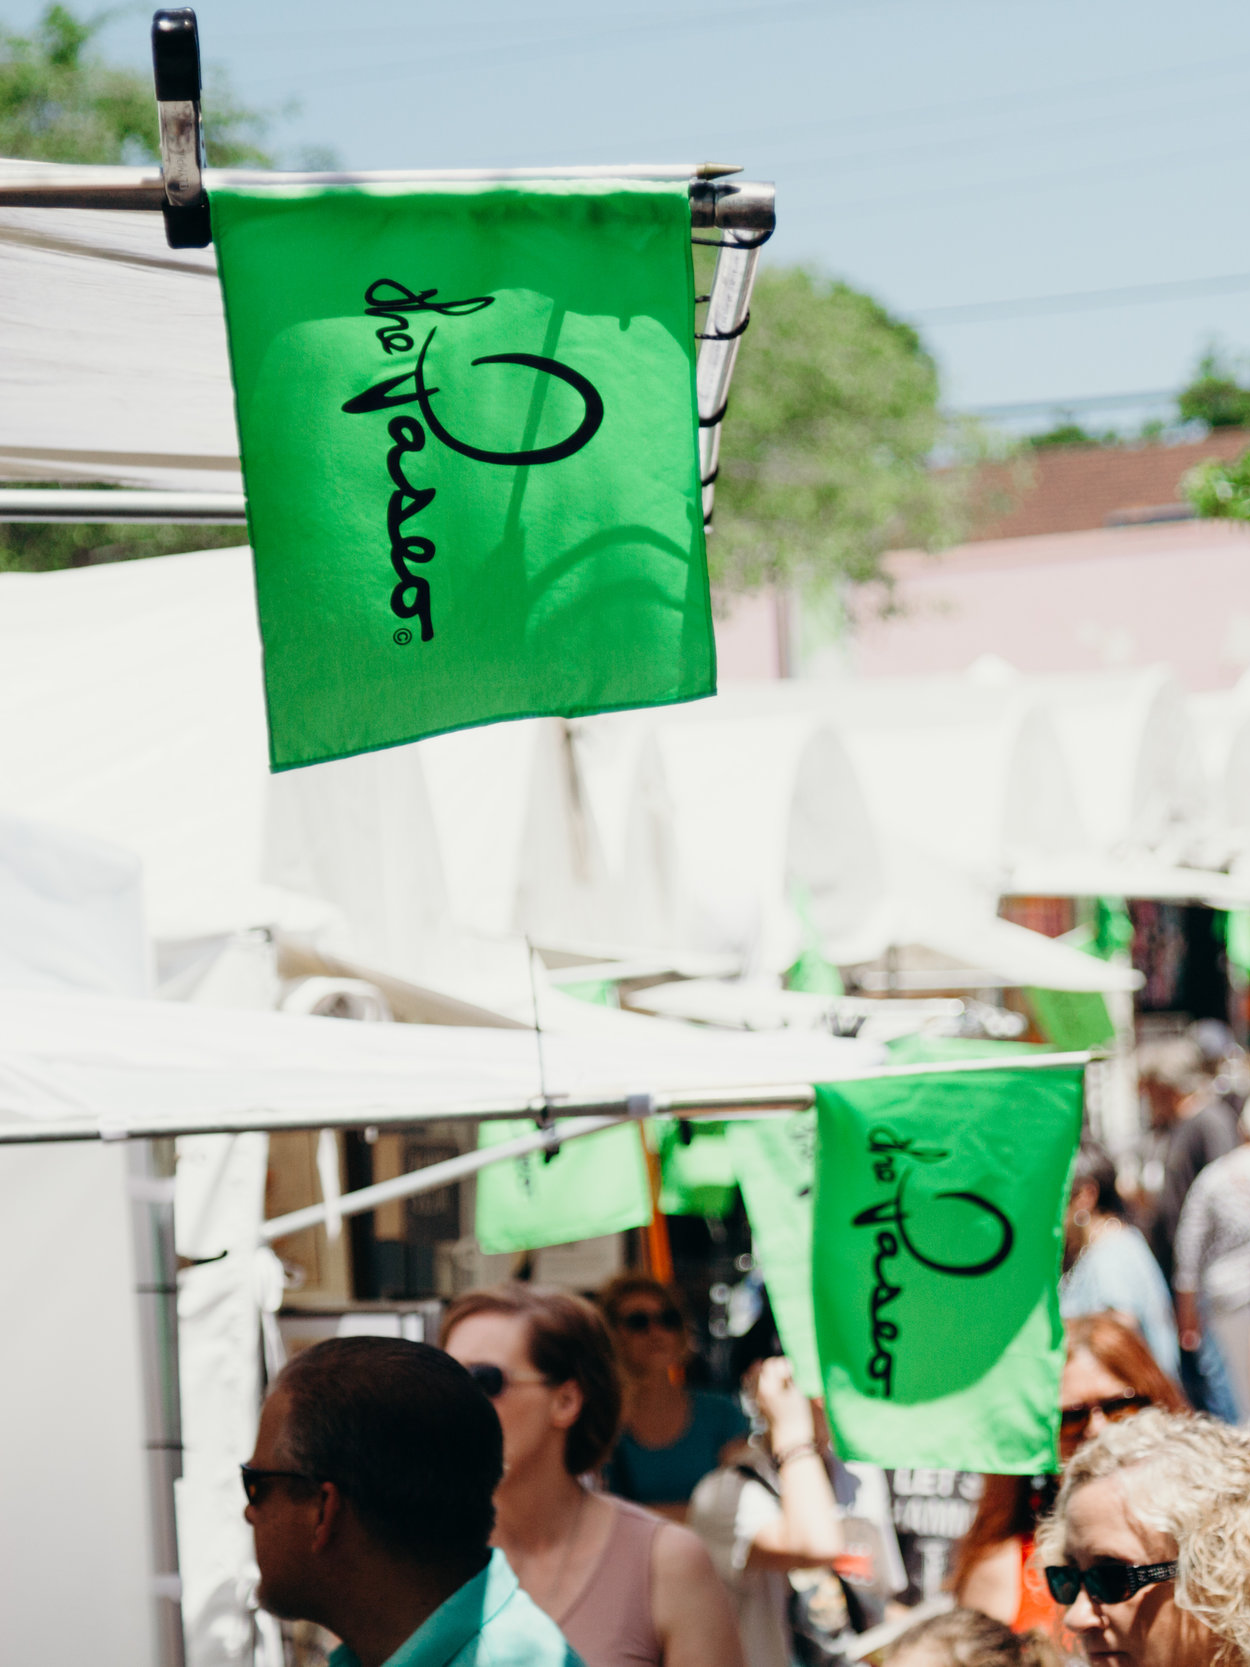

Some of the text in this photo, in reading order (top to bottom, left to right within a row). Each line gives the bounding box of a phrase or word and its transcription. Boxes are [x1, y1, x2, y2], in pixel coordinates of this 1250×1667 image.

[364, 278, 495, 355] the
[341, 325, 604, 642] Paseo
[867, 1127, 948, 1184] the
[851, 1166, 1014, 1398] Paseo
